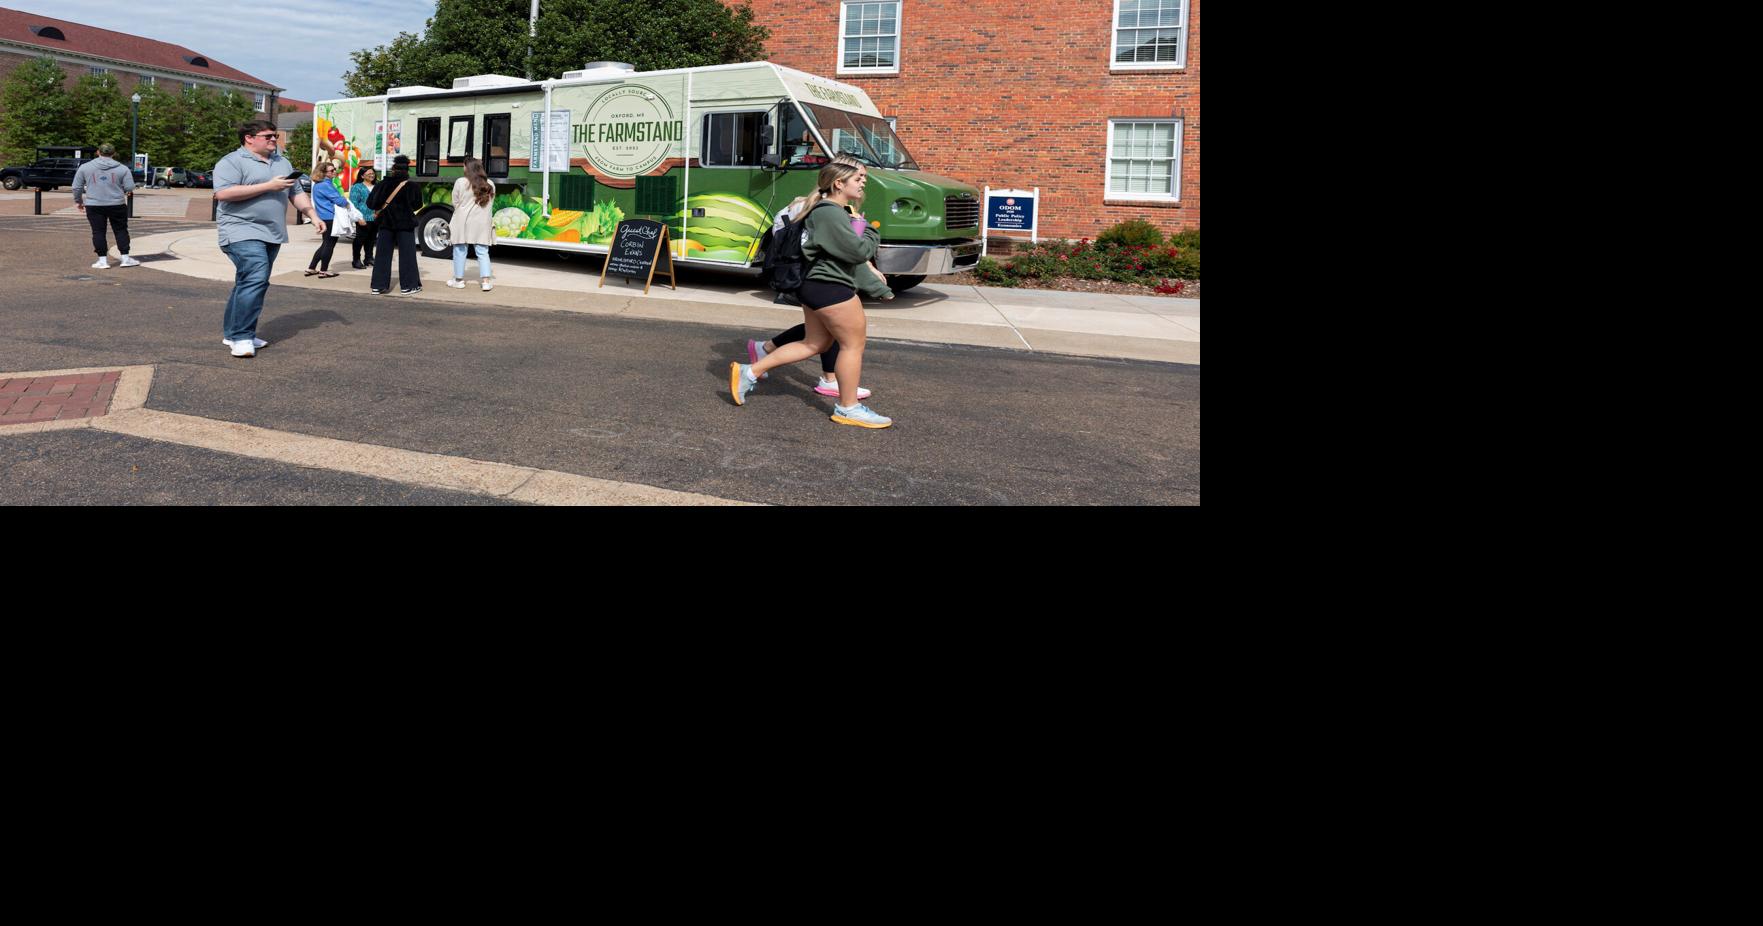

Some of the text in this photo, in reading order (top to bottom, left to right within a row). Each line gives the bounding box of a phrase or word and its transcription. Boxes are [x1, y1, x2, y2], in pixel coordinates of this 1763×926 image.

[602, 89, 626, 103] LOCALLY
[572, 123, 596, 143] THE
[598, 120, 683, 143] FARMSTAND
[594, 156, 608, 167] FROM
[635, 156, 657, 170] CAMPUS
